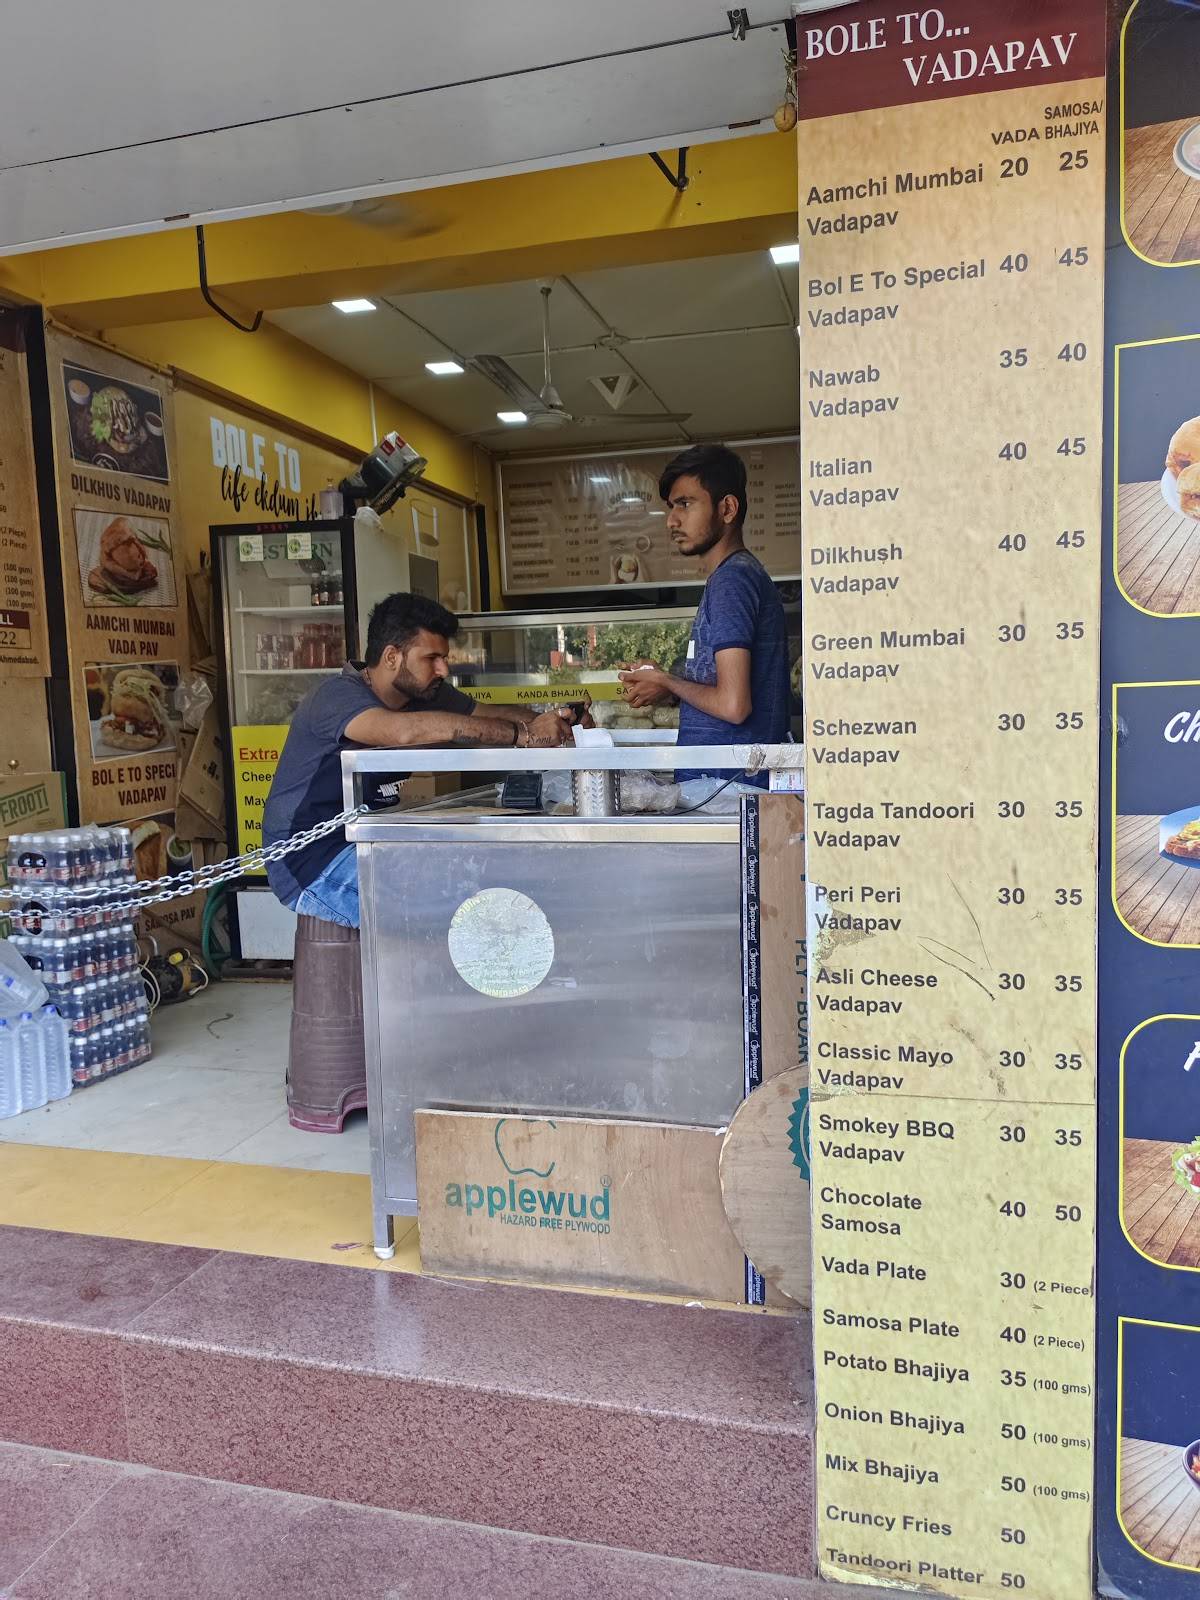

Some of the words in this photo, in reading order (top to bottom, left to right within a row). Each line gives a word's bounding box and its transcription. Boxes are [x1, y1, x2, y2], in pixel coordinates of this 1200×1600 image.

[805, 17, 887, 60] BOLE
[896, 8, 970, 45] TO...
[901, 30, 1079, 89] VADAPAV
[1044, 99, 1104, 120] SAMOSA/
[991, 127, 1041, 146] VADA
[1044, 120, 1099, 140] BHAJIYA
[806, 176, 887, 206] Aamchi
[895, 163, 983, 194] Mumbai
[999, 156, 1029, 179] 20
[1059, 149, 1089, 172] 25
[806, 210, 899, 236] Vadapav
[808, 275, 842, 298] Bol
[850, 273, 864, 293] E
[870, 270, 897, 290] To
[903, 258, 985, 289] Special
[999, 253, 1029, 274] 40
[1058, 246, 1089, 267] 45
[807, 304, 899, 328] Vadapav
[809, 364, 880, 389] Nawab
[999, 348, 1028, 369] 35
[1057, 342, 1087, 363] 40
[808, 396, 900, 418] Vadapav
[210, 416, 267, 483] BOLE
[274, 441, 301, 493] TO
[810, 457, 872, 478] Italian
[998, 441, 1027, 461] 40
[1056, 437, 1087, 457] 45
[71, 473, 121, 501] DILKHUS
[123, 488, 171, 513] VADAPAV
[221, 464, 249, 512] life
[809, 487, 900, 508] Vadapav
[810, 543, 903, 566] Dilkhush
[998, 533, 1027, 552] 40
[1055, 530, 1086, 549] 45
[809, 575, 900, 596] Vadapav
[86, 614, 130, 632] AAMCHI
[133, 619, 175, 637] MUMBAI
[811, 634, 873, 652] Green
[880, 627, 965, 649] Mumbai
[998, 624, 1026, 643] 30
[1055, 621, 1085, 640] 35
[108, 638, 136, 654] VADA
[139, 641, 159, 657] PAV
[811, 661, 900, 682] Vadapav
[467, 691, 492, 700] AJIYA
[517, 690, 549, 700] KANDA
[551, 688, 589, 698] BHAJIYA
[616, 687, 632, 695] SA
[812, 718, 917, 737] Schezwan
[997, 713, 1026, 732] 30
[1055, 711, 1084, 730] 35
[239, 747, 279, 761] Extra
[812, 747, 900, 767] Vadapav
[92, 769, 115, 786] BOL
[117, 768, 125, 784] E
[127, 766, 142, 782] TO
[0, 787, 49, 823] FROOTI
[118, 786, 167, 806] VADAPAV
[812, 802, 874, 824] Tagda
[880, 801, 974, 819] Tandoori
[997, 800, 1025, 818] 30
[1055, 800, 1083, 818] 35
[813, 830, 901, 852] Vadapav
[814, 886, 853, 903] Peri
[861, 886, 901, 903] Peri
[998, 887, 1025, 905] 30
[1054, 888, 1083, 906] 35
[814, 913, 902, 932] Vadapav
[816, 968, 854, 986] Asli
[860, 968, 938, 988] Cheese
[998, 972, 1026, 991] 30
[1054, 974, 1083, 993] 35
[815, 994, 903, 1017] Vadapav
[817, 1041, 892, 1061] Classic
[898, 1045, 954, 1068] Mayo
[999, 1050, 1026, 1068] 30
[1054, 1053, 1082, 1071] 35
[817, 1068, 904, 1091] Vadapav
[819, 1113, 900, 1139] Smokey
[906, 1119, 955, 1140] BBQ
[999, 1125, 1026, 1143] 30
[1055, 1128, 1082, 1147] 35
[819, 1140, 905, 1165] Vadapav
[445, 1178, 612, 1222] applewud
[820, 1186, 922, 1210] Chocolate
[999, 1200, 1026, 1218] 40
[1055, 1204, 1082, 1222] 50
[500, 1213, 537, 1227] HAZARD
[539, 1217, 563, 1230] FREE
[565, 1219, 611, 1234] PLYWOOD
[821, 1213, 901, 1236] Samosa
[821, 1255, 870, 1276] Vada
[876, 1260, 927, 1281] Plate
[1000, 1271, 1026, 1290] 30
[1033, 1280, 1046, 1294] (2
[822, 1308, 902, 1332] Samosa
[909, 1317, 960, 1338] Plate
[999, 1326, 1027, 1344] 40
[1033, 1334, 1045, 1348] (2
[1048, 1336, 1085, 1352] Piece)
[823, 1350, 887, 1372] Potato
[894, 1357, 969, 1384] Bhajiya
[1000, 1369, 1027, 1387] 35
[1033, 1378, 1059, 1391] (100
[1061, 1383, 1091, 1397] gms)
[824, 1402, 883, 1424] Onion
[890, 1410, 965, 1436] Bhajiya
[1001, 1423, 1026, 1441] 50
[1033, 1432, 1058, 1445] (100
[1061, 1437, 1091, 1450] gms)
[825, 1453, 859, 1473] Mix
[865, 1458, 939, 1485] Bhajiya
[1001, 1475, 1026, 1493] 50
[1033, 1484, 1058, 1497] (100
[1060, 1490, 1090, 1503] gms)
[826, 1505, 896, 1532] Cruncy
[902, 1515, 952, 1536] Fries
[1000, 1527, 1026, 1545] 50
[826, 1548, 912, 1574] Tandoori
[918, 1561, 985, 1588] Platter
[1000, 1572, 1026, 1589] 50
